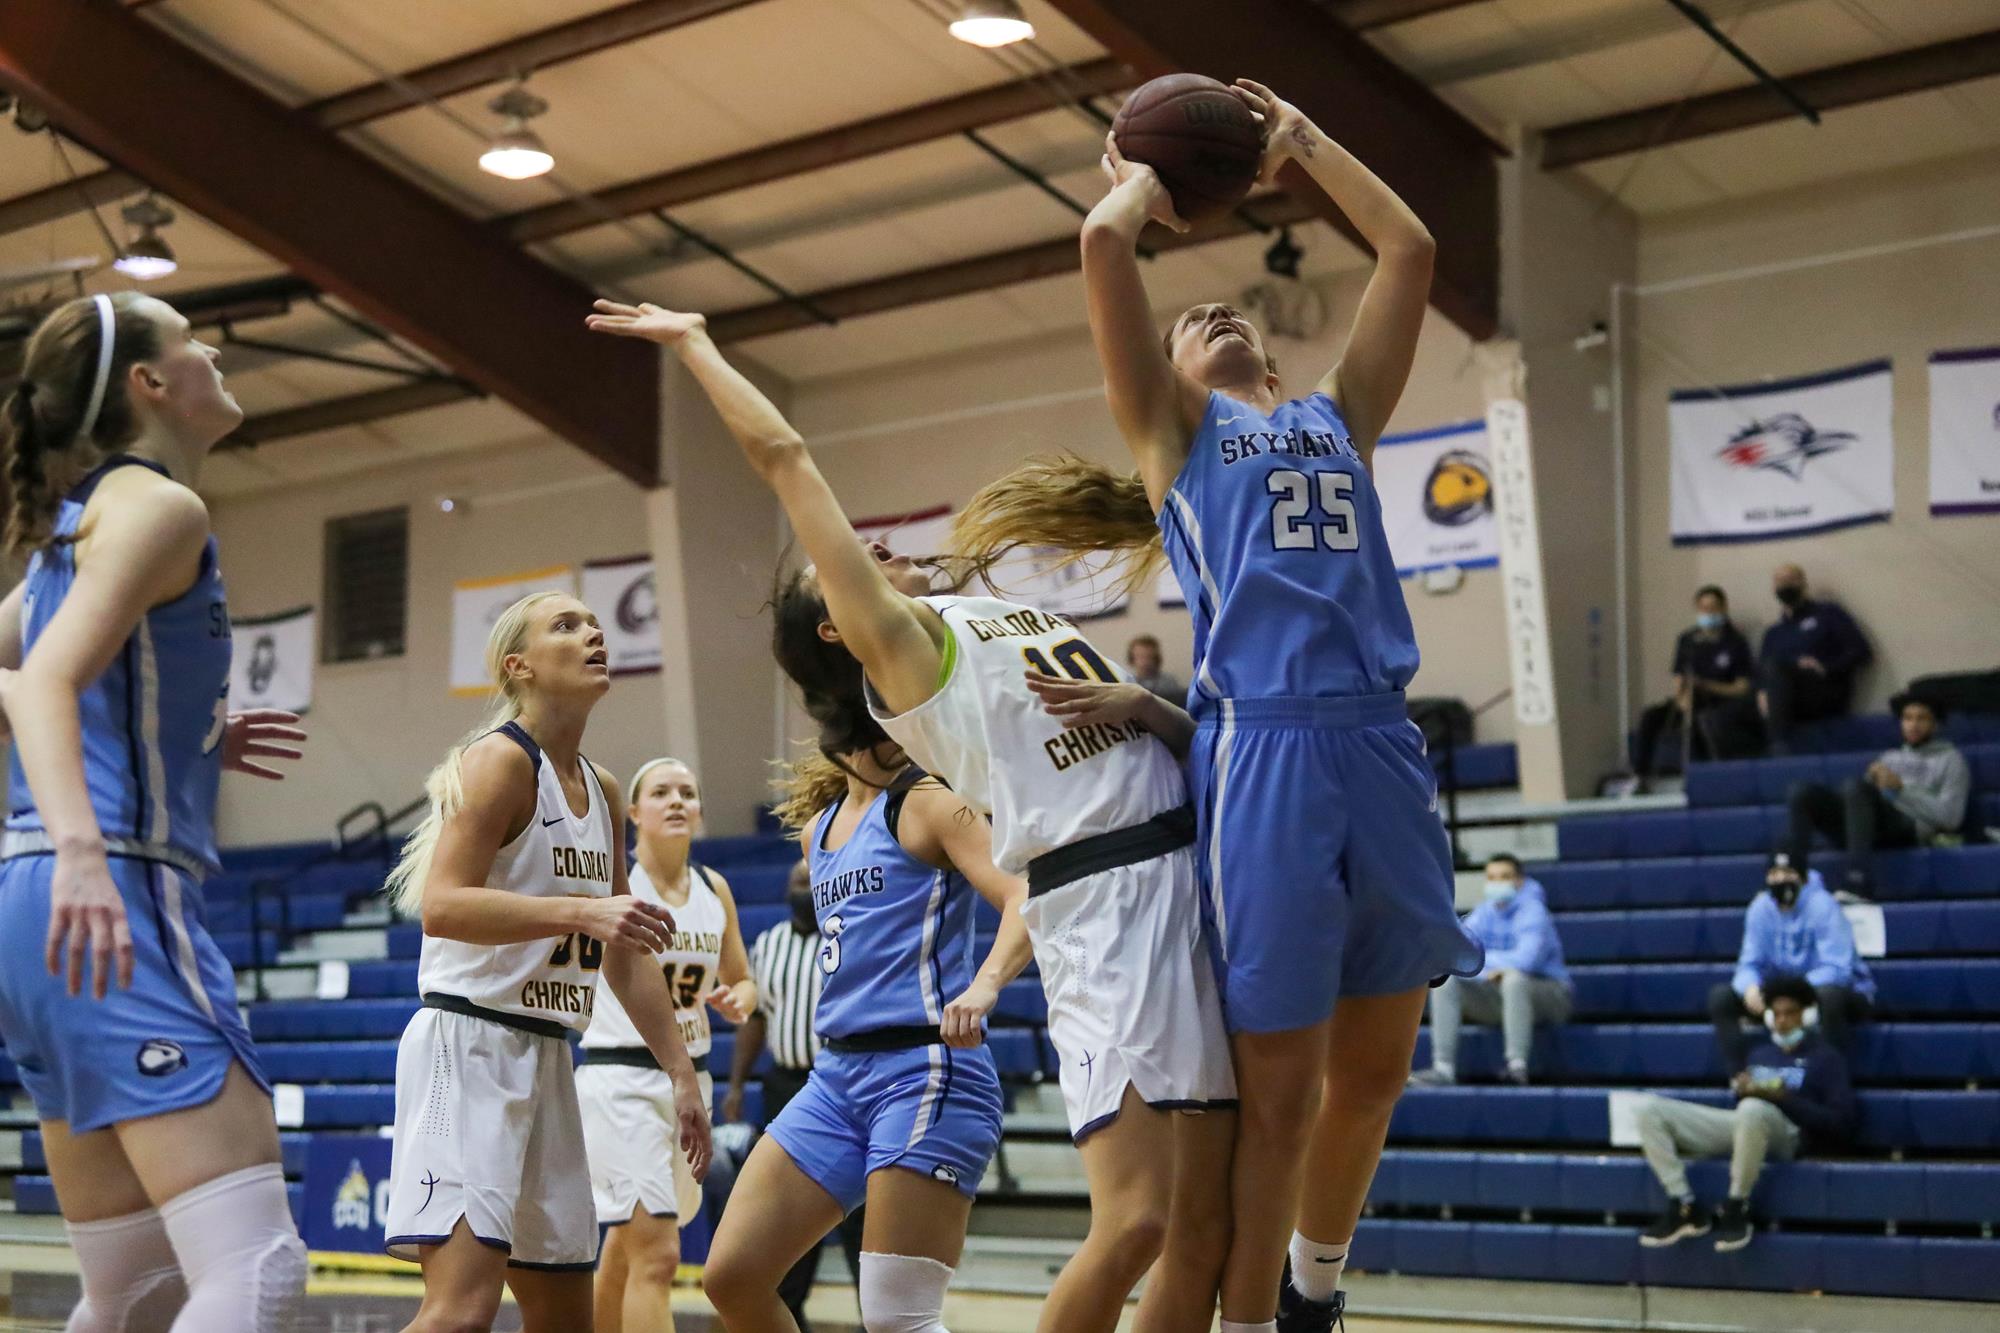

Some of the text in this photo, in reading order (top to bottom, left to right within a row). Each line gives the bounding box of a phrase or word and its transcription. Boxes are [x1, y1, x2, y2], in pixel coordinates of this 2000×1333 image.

[1220, 427, 1362, 466] SKYHAWS
[1264, 467, 1361, 552] 25
[966, 609, 1073, 643] COLORA
[1022, 635, 1121, 684] 10
[662, 962, 705, 1010] 12
